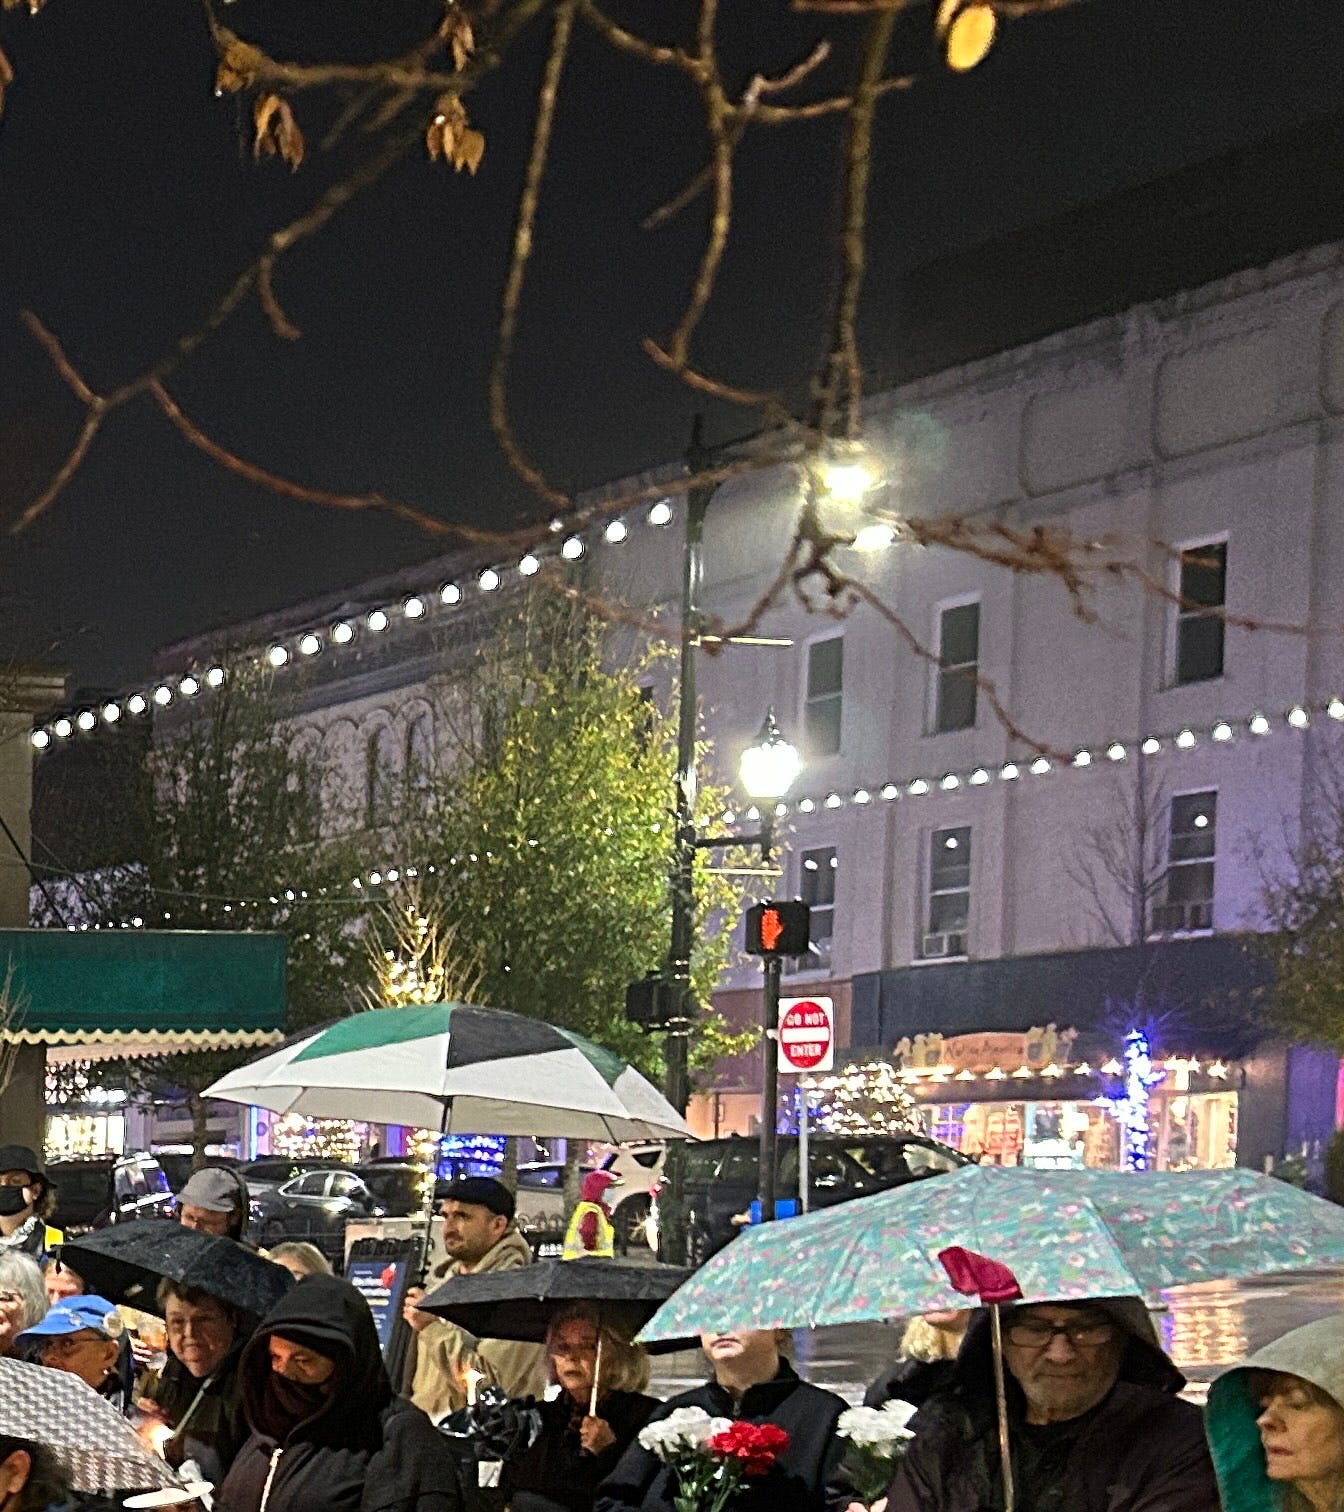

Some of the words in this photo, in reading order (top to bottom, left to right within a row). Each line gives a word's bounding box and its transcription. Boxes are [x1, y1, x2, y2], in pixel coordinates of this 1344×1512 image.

[786, 1013, 802, 1026] DO
[804, 1012, 826, 1026] NOT
[790, 1043, 822, 1057] ENTER
